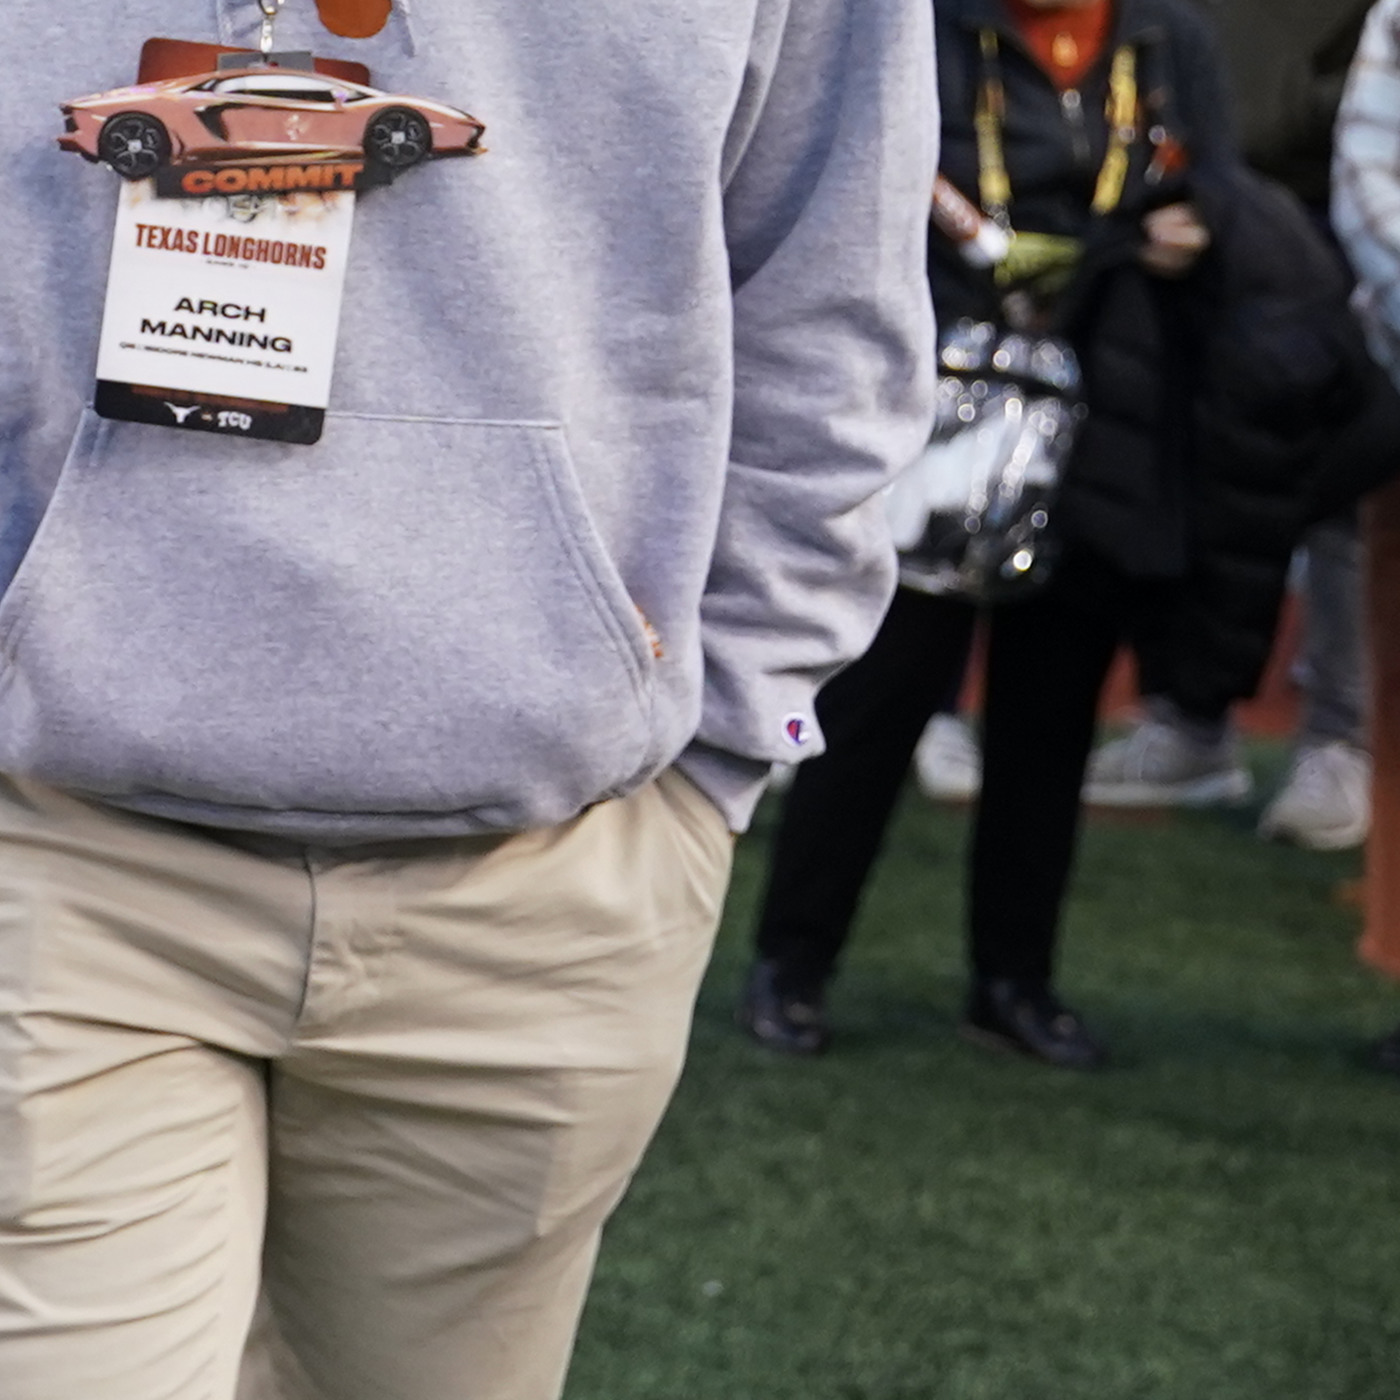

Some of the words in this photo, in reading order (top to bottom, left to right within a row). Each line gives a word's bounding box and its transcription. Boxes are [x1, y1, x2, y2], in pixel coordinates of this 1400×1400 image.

[181, 163, 364, 194] COMMIT
[135, 223, 199, 254] TEXAS
[203, 232, 327, 271] LONGHORNS
[174, 297, 266, 323] ARCH
[140, 318, 293, 353] MANNING
[217, 410, 253, 431] TCU
